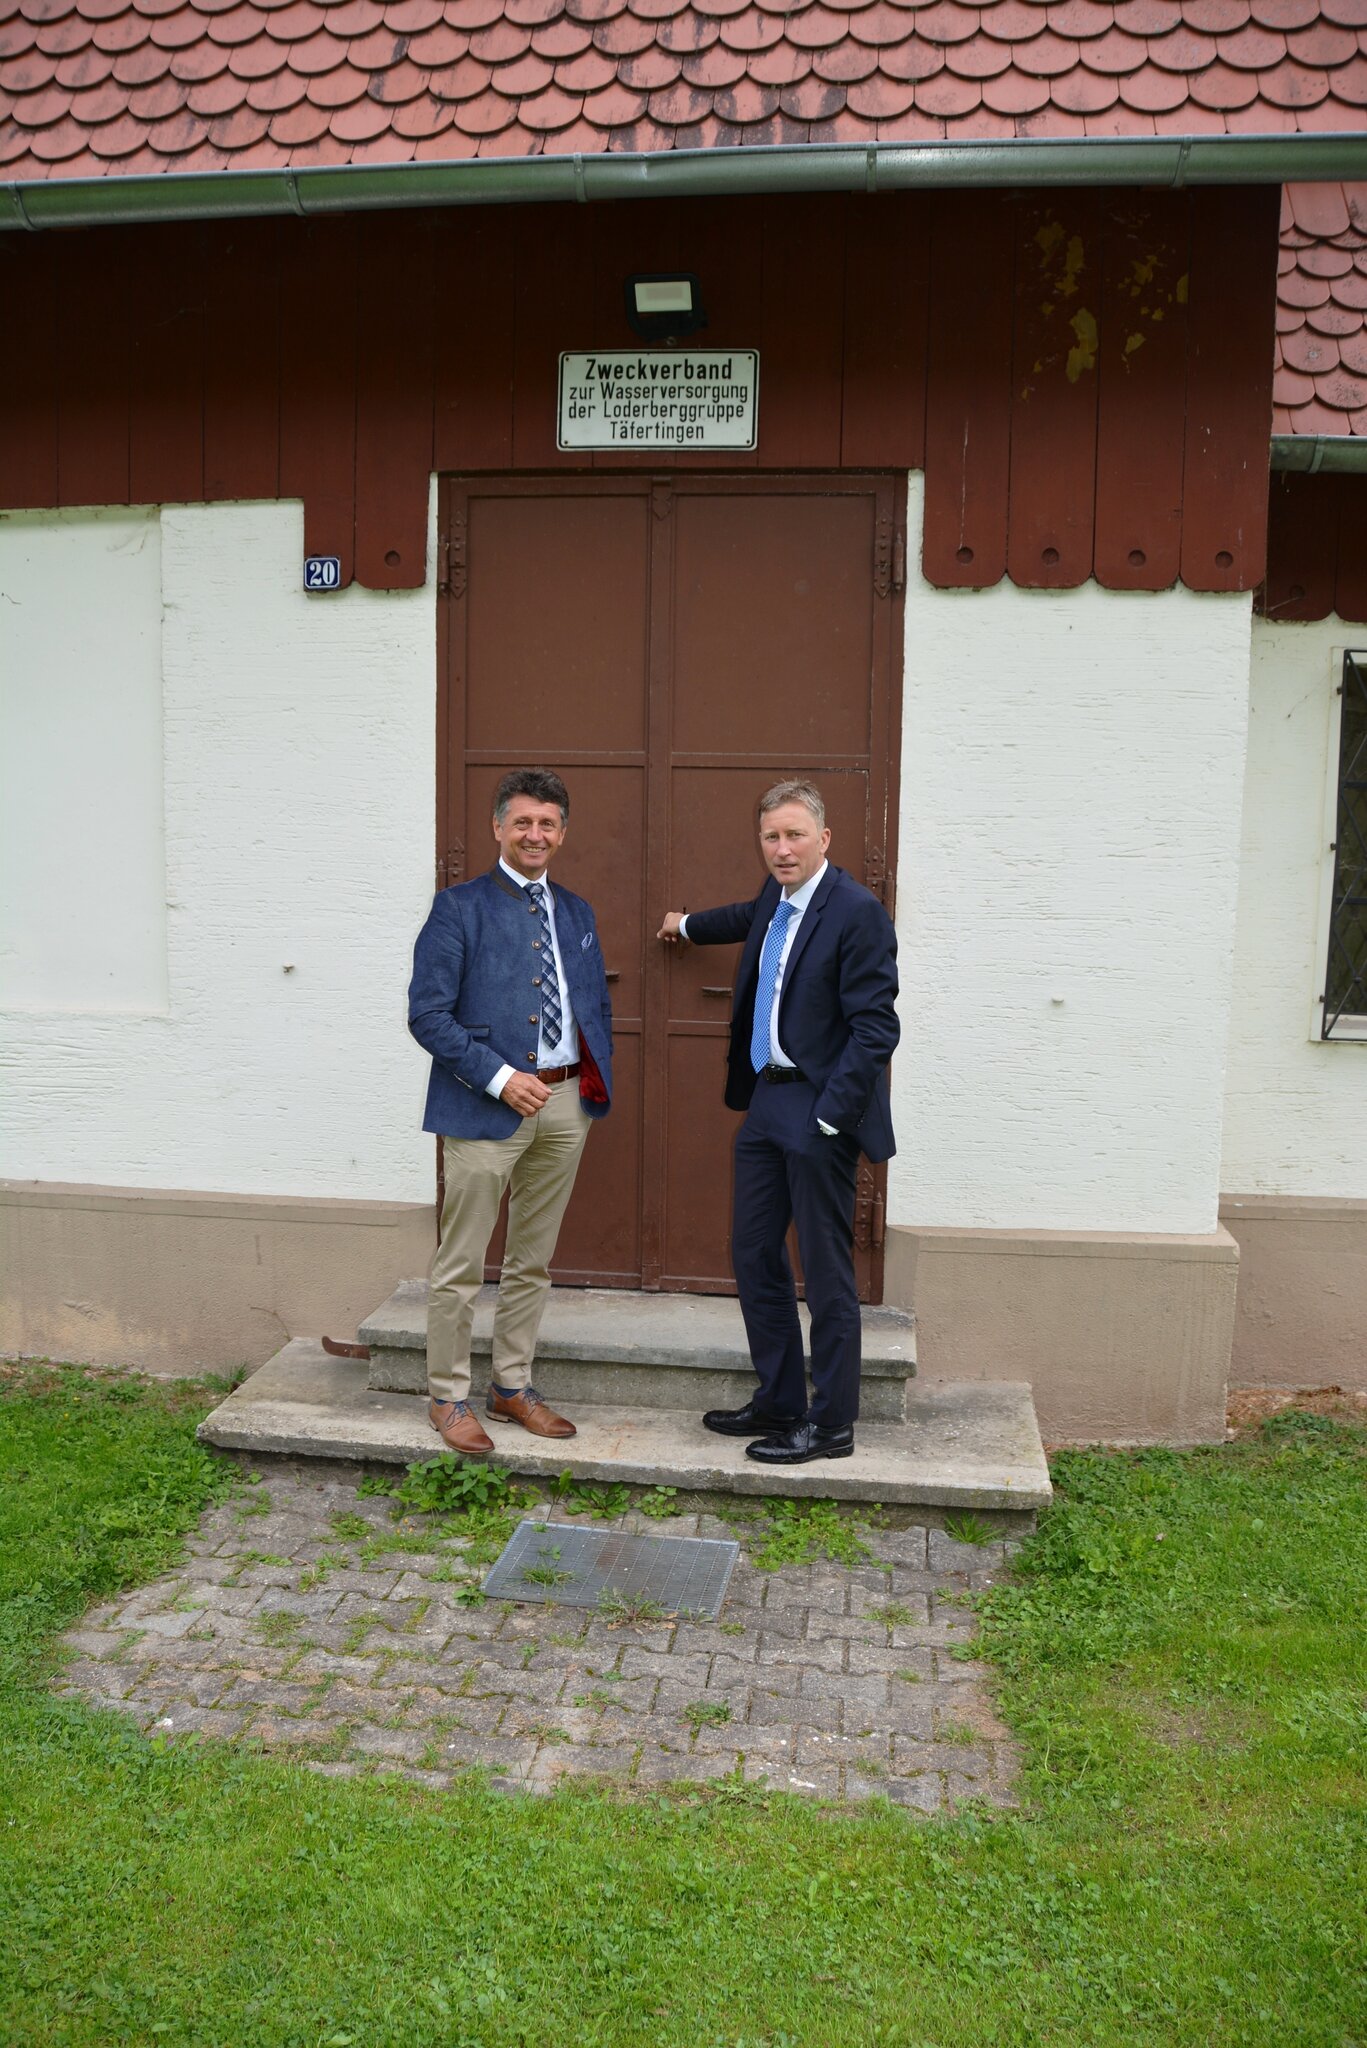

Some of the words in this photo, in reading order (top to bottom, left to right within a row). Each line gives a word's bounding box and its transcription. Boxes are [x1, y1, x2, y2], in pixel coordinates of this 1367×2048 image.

[585, 358, 732, 380] Zweckverband
[569, 386, 595, 400] zur
[600, 381, 748, 404] Wasserversorgung
[568, 401, 596, 419] der
[603, 400, 744, 423] Loderberggruppe
[610, 421, 704, 443] Täfertingen
[310, 561, 335, 585] 20
